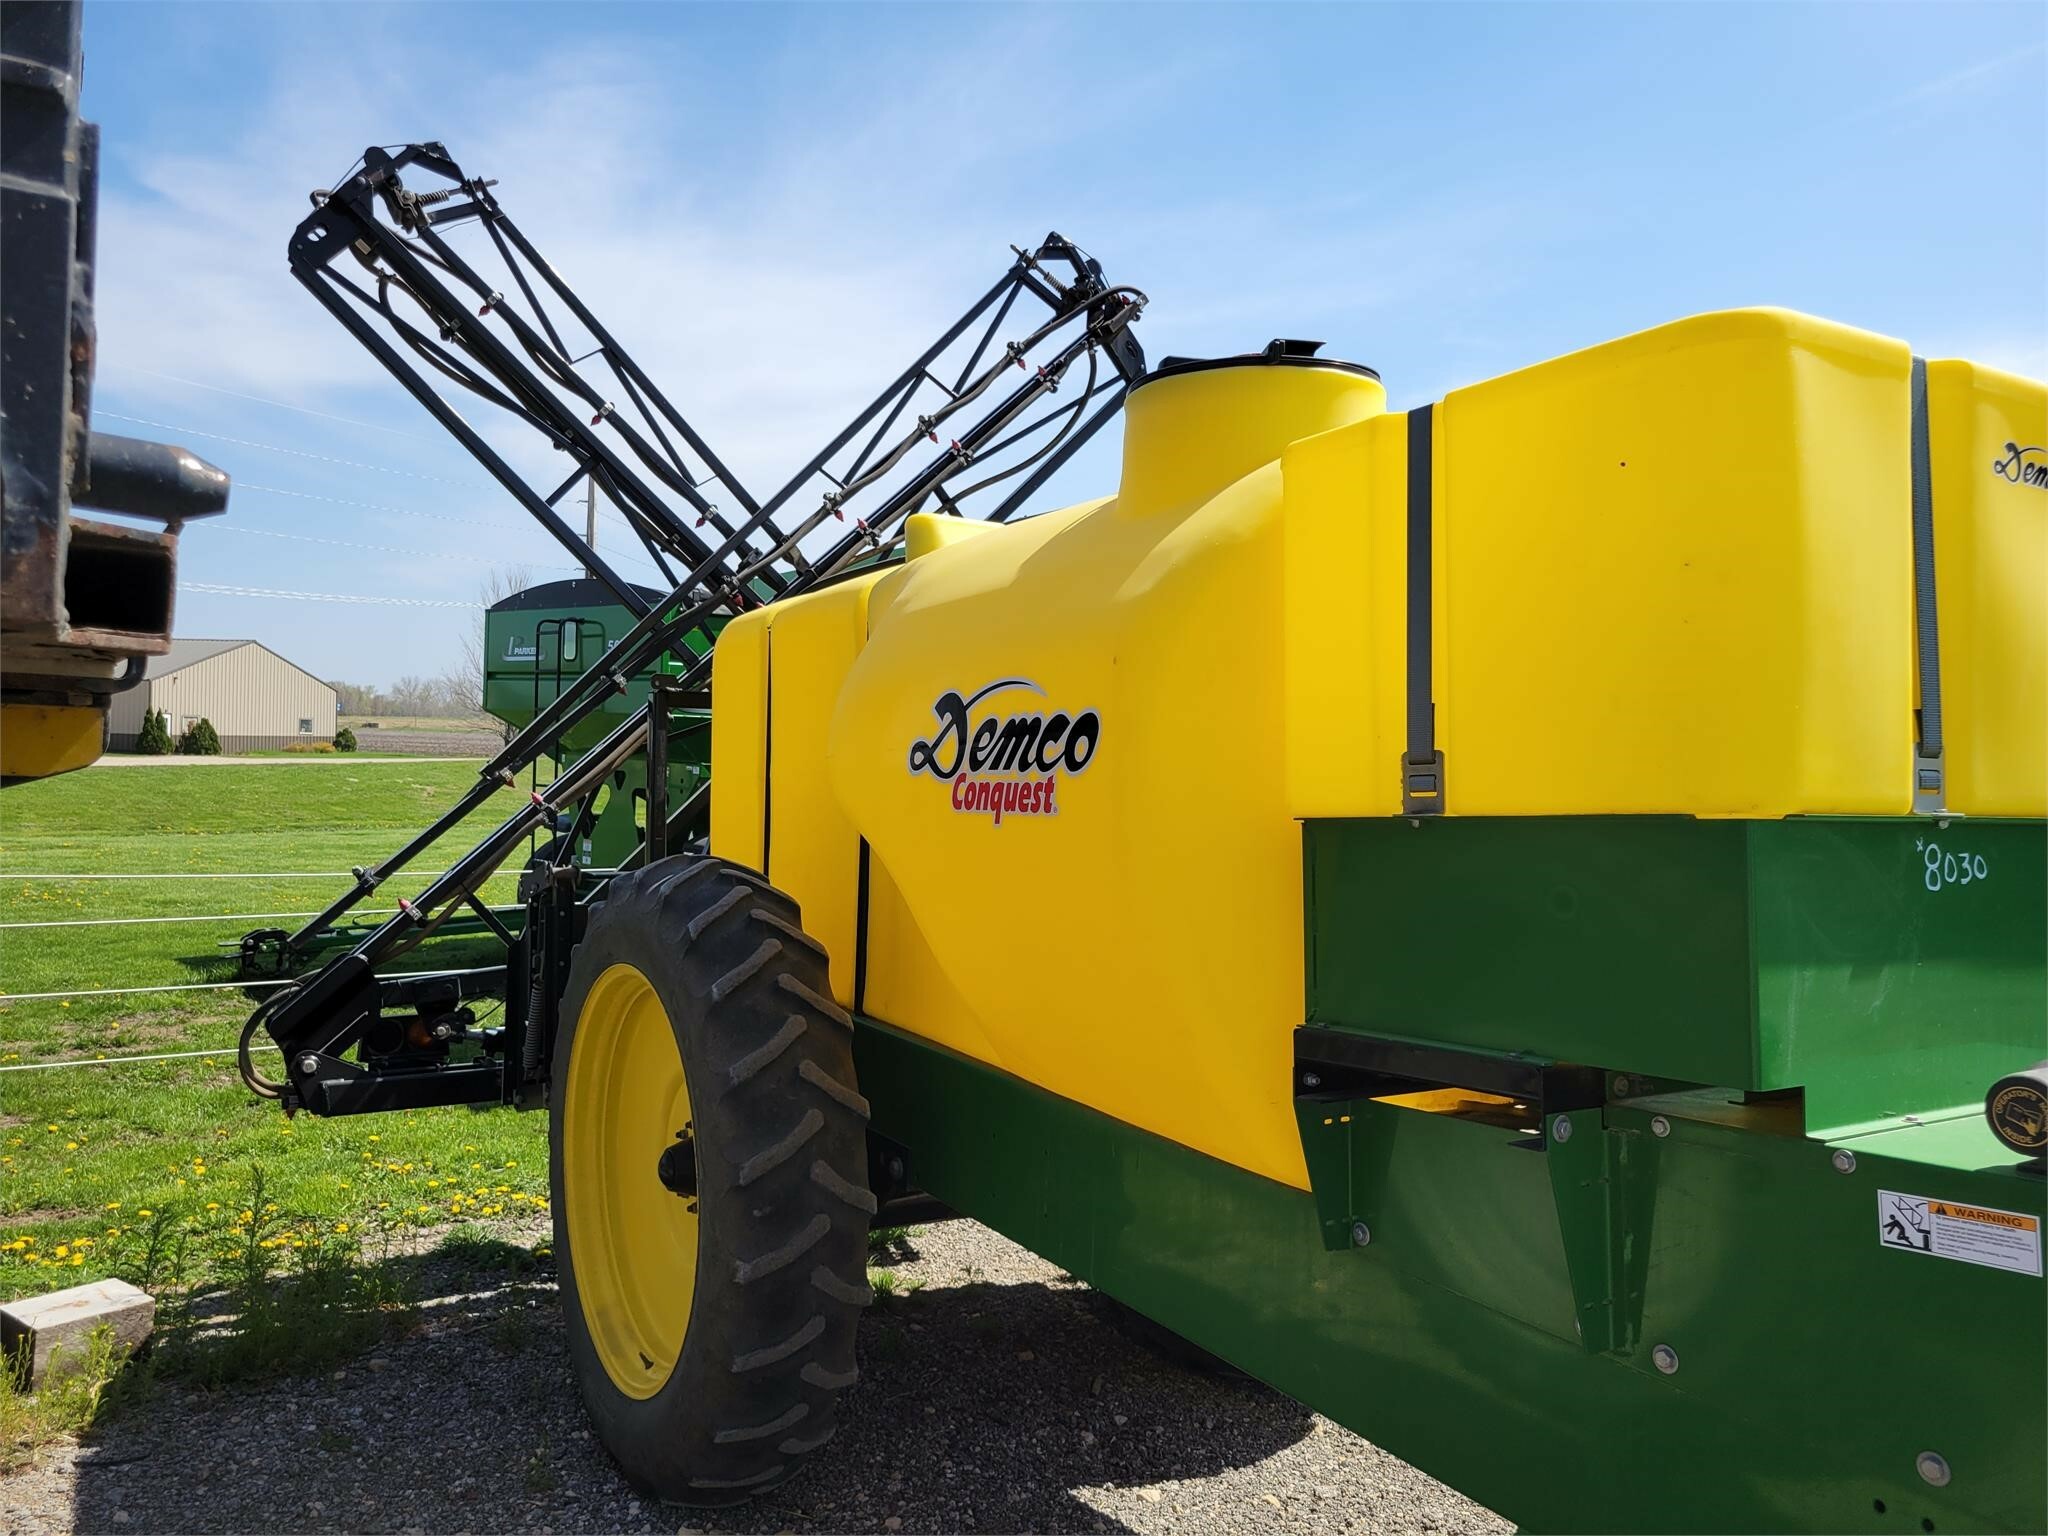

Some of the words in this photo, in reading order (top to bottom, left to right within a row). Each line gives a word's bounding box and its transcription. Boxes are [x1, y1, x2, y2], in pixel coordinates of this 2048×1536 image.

[909, 680, 1099, 780] Demco
[952, 772, 1055, 825] Conquest
[1953, 1207, 2022, 1227] WARNING
